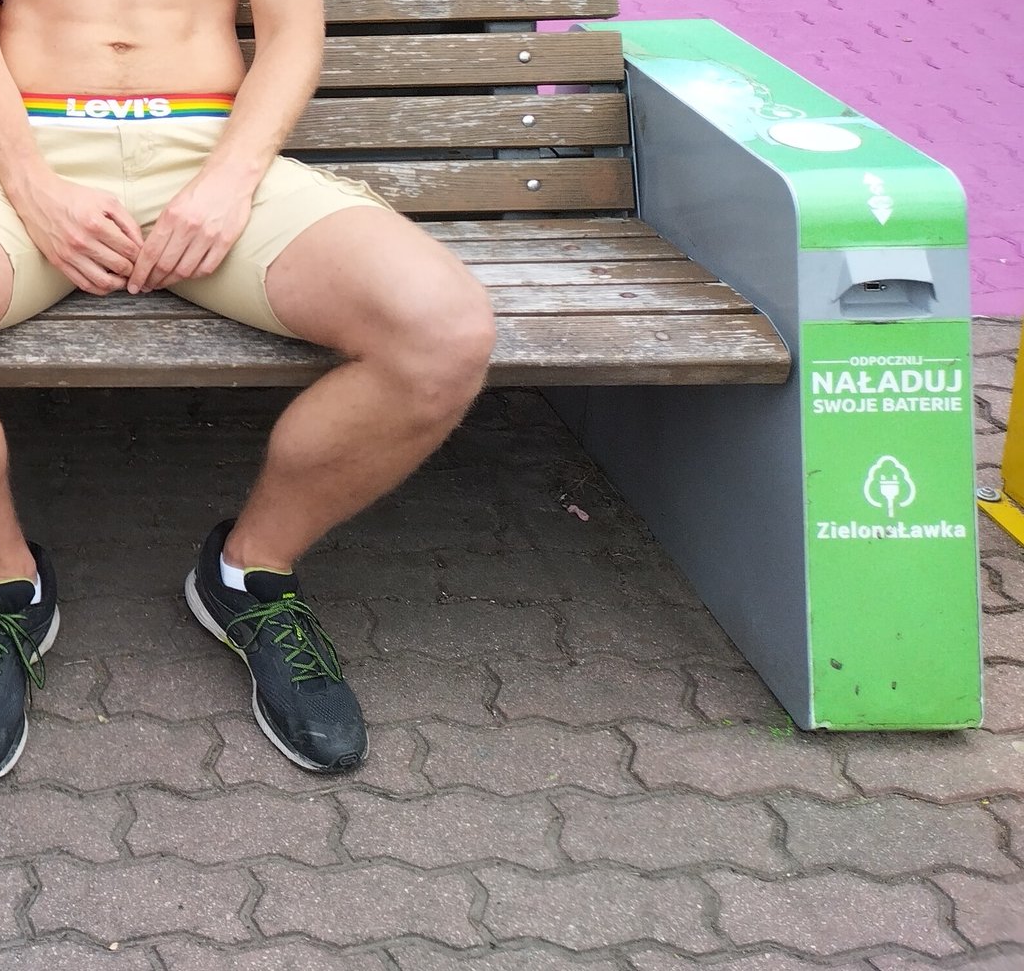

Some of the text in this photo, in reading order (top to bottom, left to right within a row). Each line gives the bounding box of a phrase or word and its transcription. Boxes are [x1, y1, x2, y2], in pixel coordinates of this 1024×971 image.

[849, 355, 923, 367] ODPOCZNIJ
[811, 369, 963, 395] NAŁADUJ
[812, 397, 963, 414] SWOJE BATERIE
